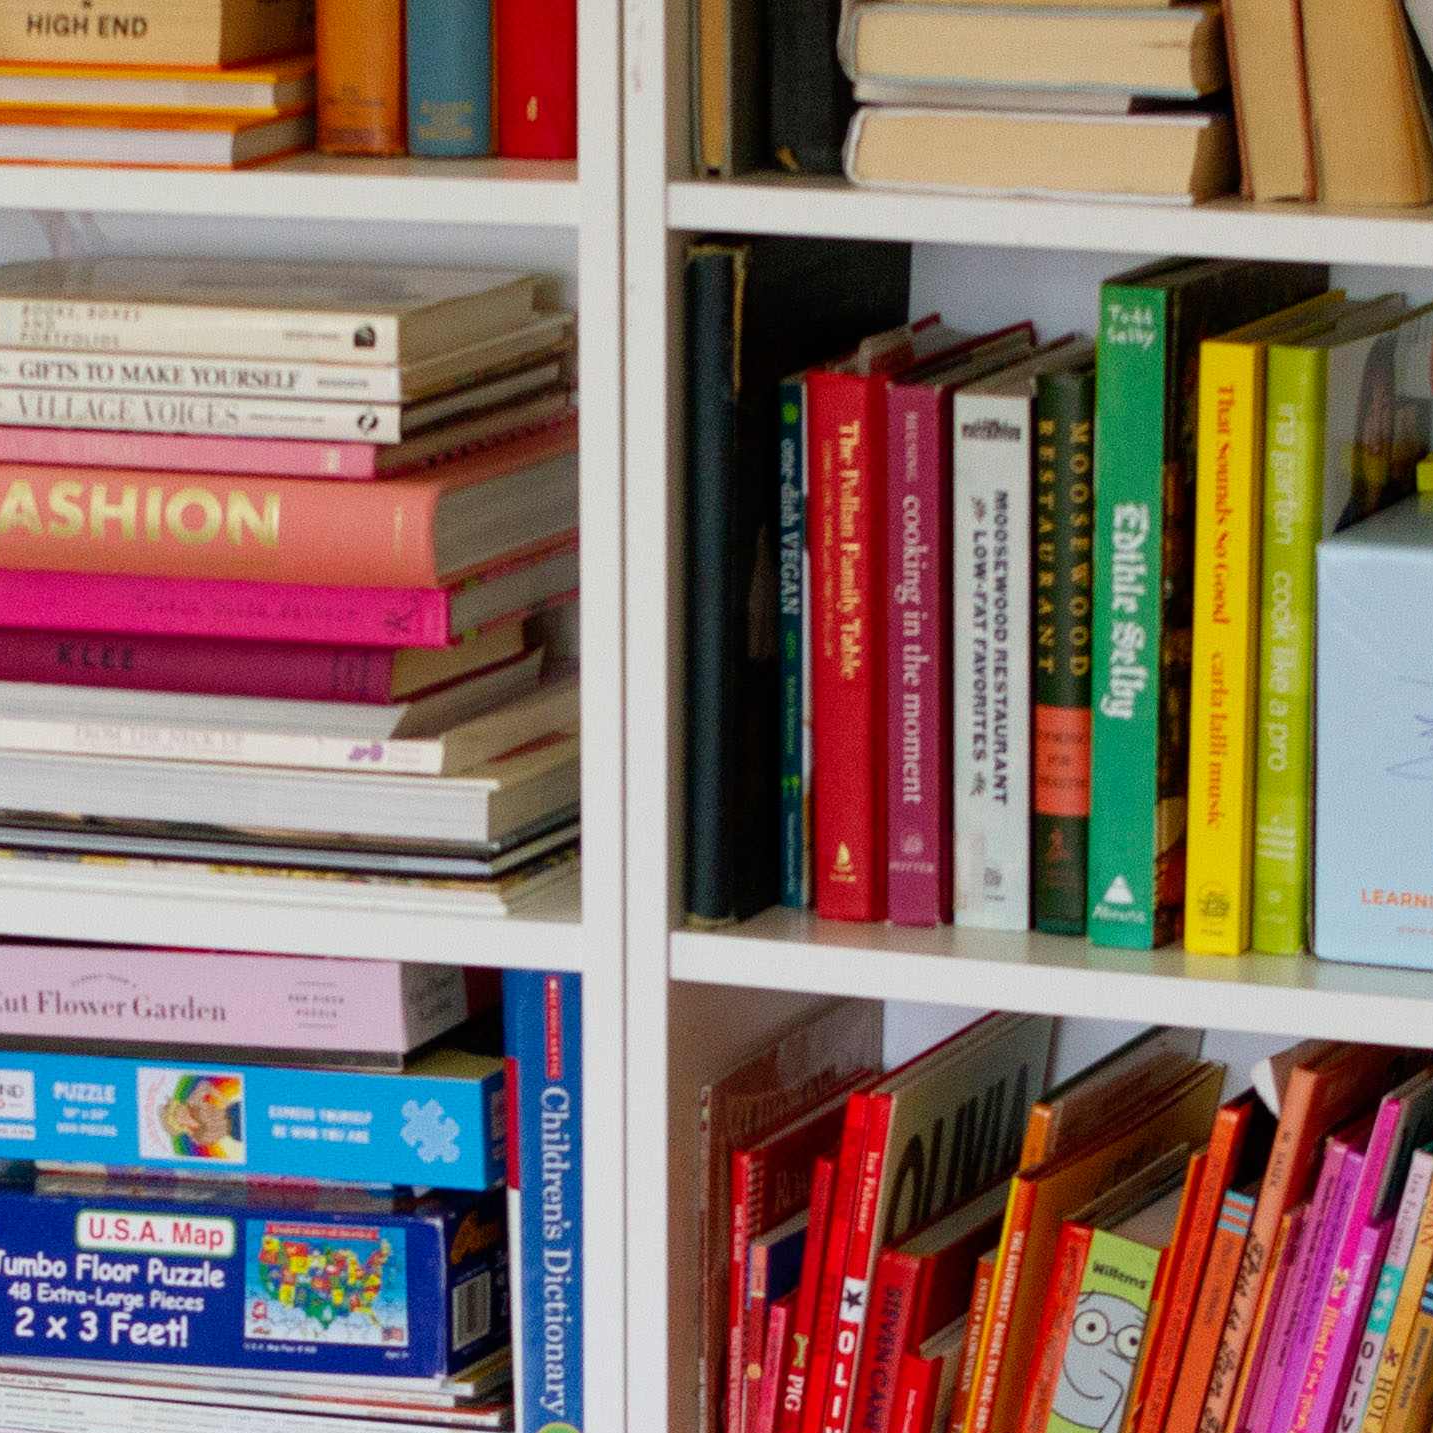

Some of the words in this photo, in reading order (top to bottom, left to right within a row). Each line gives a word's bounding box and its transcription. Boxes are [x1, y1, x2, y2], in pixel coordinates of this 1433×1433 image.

[26, 13, 89, 37] HIGH
[98, 16, 147, 40] END
[19, 361, 79, 381] GIFTS
[85, 363, 114, 382] TO
[121, 364, 184, 385] MAKE
[189, 366, 302, 390] YOURSELF
[16, 393, 135, 422] VILLAGE
[143, 399, 239, 427] VOICES
[839, 421, 861, 465] The
[780, 437, 800, 528] one-dish
[839, 469, 861, 537] Pollan
[781, 531, 800, 615] VEGAN
[837, 542, 862, 613] Family
[894, 494, 929, 605] cooking
[992, 489, 1009, 643] MOOSEWOOD
[1037, 420, 1056, 674] RESTAURANT
[1069, 420, 1090, 677] MOOSEWOOD
[1111, 502, 1150, 613] Edible
[972, 530, 988, 632] LOW-FAT
[839, 617, 861, 680] Table
[902, 610, 929, 637] in
[56, 642, 135, 671] KLEE
[902, 643, 931, 686] the
[1099, 621, 1148, 719] Selby
[971, 638, 987, 762] FAVORITES
[991, 647, 1008, 806] RESTAURANT
[902, 692, 924, 804] moment
[37, 989, 128, 1017] Flower
[132, 995, 226, 1022] Garden
[53, 1080, 116, 1104] PUZZLE
[540, 1086, 571, 1241] Children's
[88, 1216, 165, 1245] U.S.A.
[171, 1220, 225, 1251] Map
[7, 1283, 32, 1303] 48
[36, 1285, 146, 1313] Extra-Large
[150, 1290, 205, 1313] Pieces
[74, 1253, 139, 1284] Floor
[146, 1259, 225, 1289] Puzzle
[1090, 1261, 1149, 1291] Willems
[14, 1309, 35, 1338] 2
[46, 1317, 67, 1340] x
[79, 1312, 98, 1342] 3
[111, 1315, 189, 1348] Feet!
[540, 1249, 573, 1416] Dictionary
[784, 1374, 805, 1411] PIG
[1369, 1377, 1393, 1422] HOT
